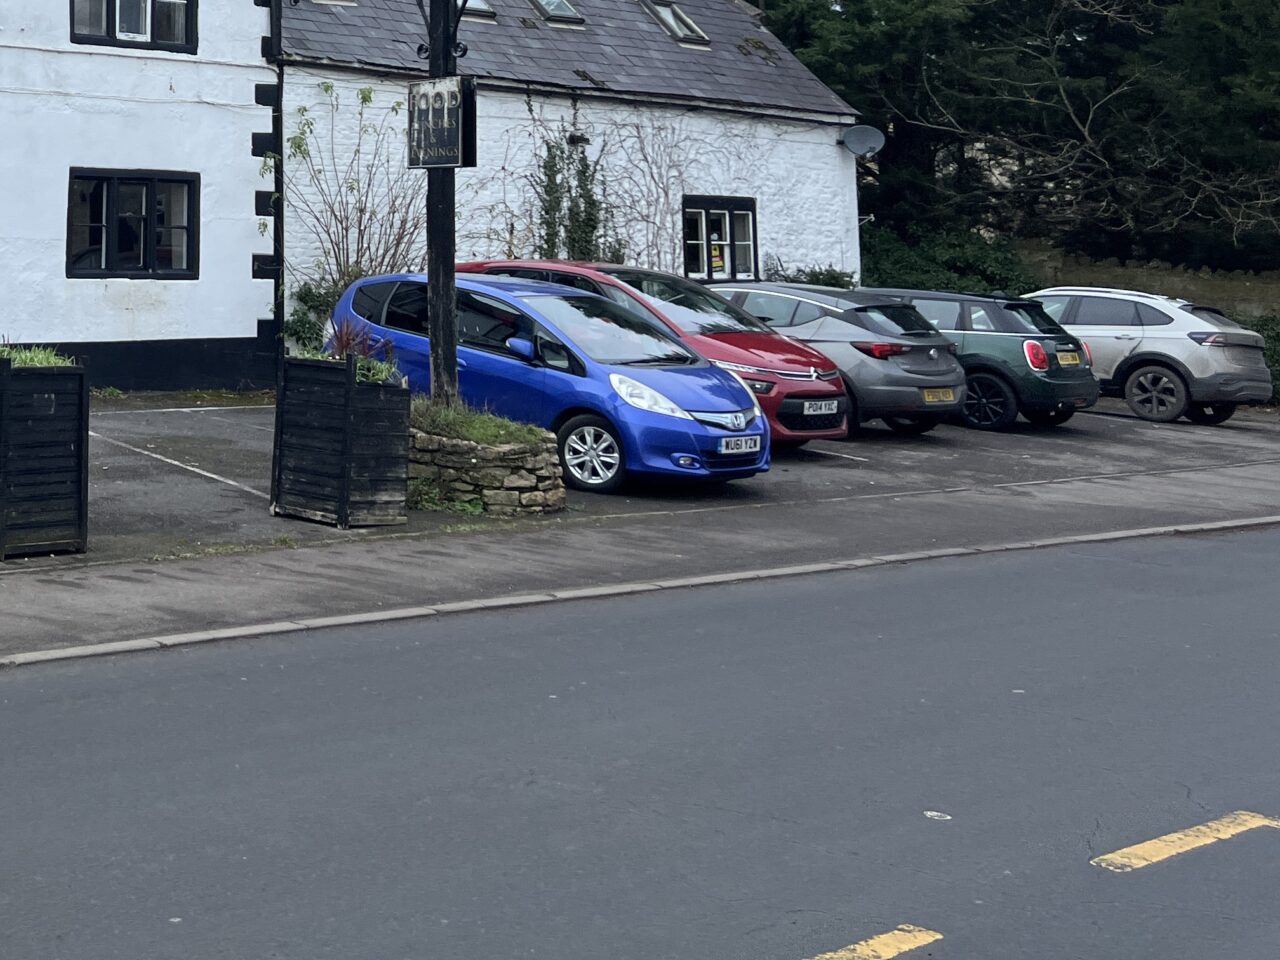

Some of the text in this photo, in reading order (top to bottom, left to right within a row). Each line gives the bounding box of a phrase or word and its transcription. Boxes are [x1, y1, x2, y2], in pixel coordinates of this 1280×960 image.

[409, 91, 461, 111] FOOD
[724, 437, 758, 451] WU61 YZW
